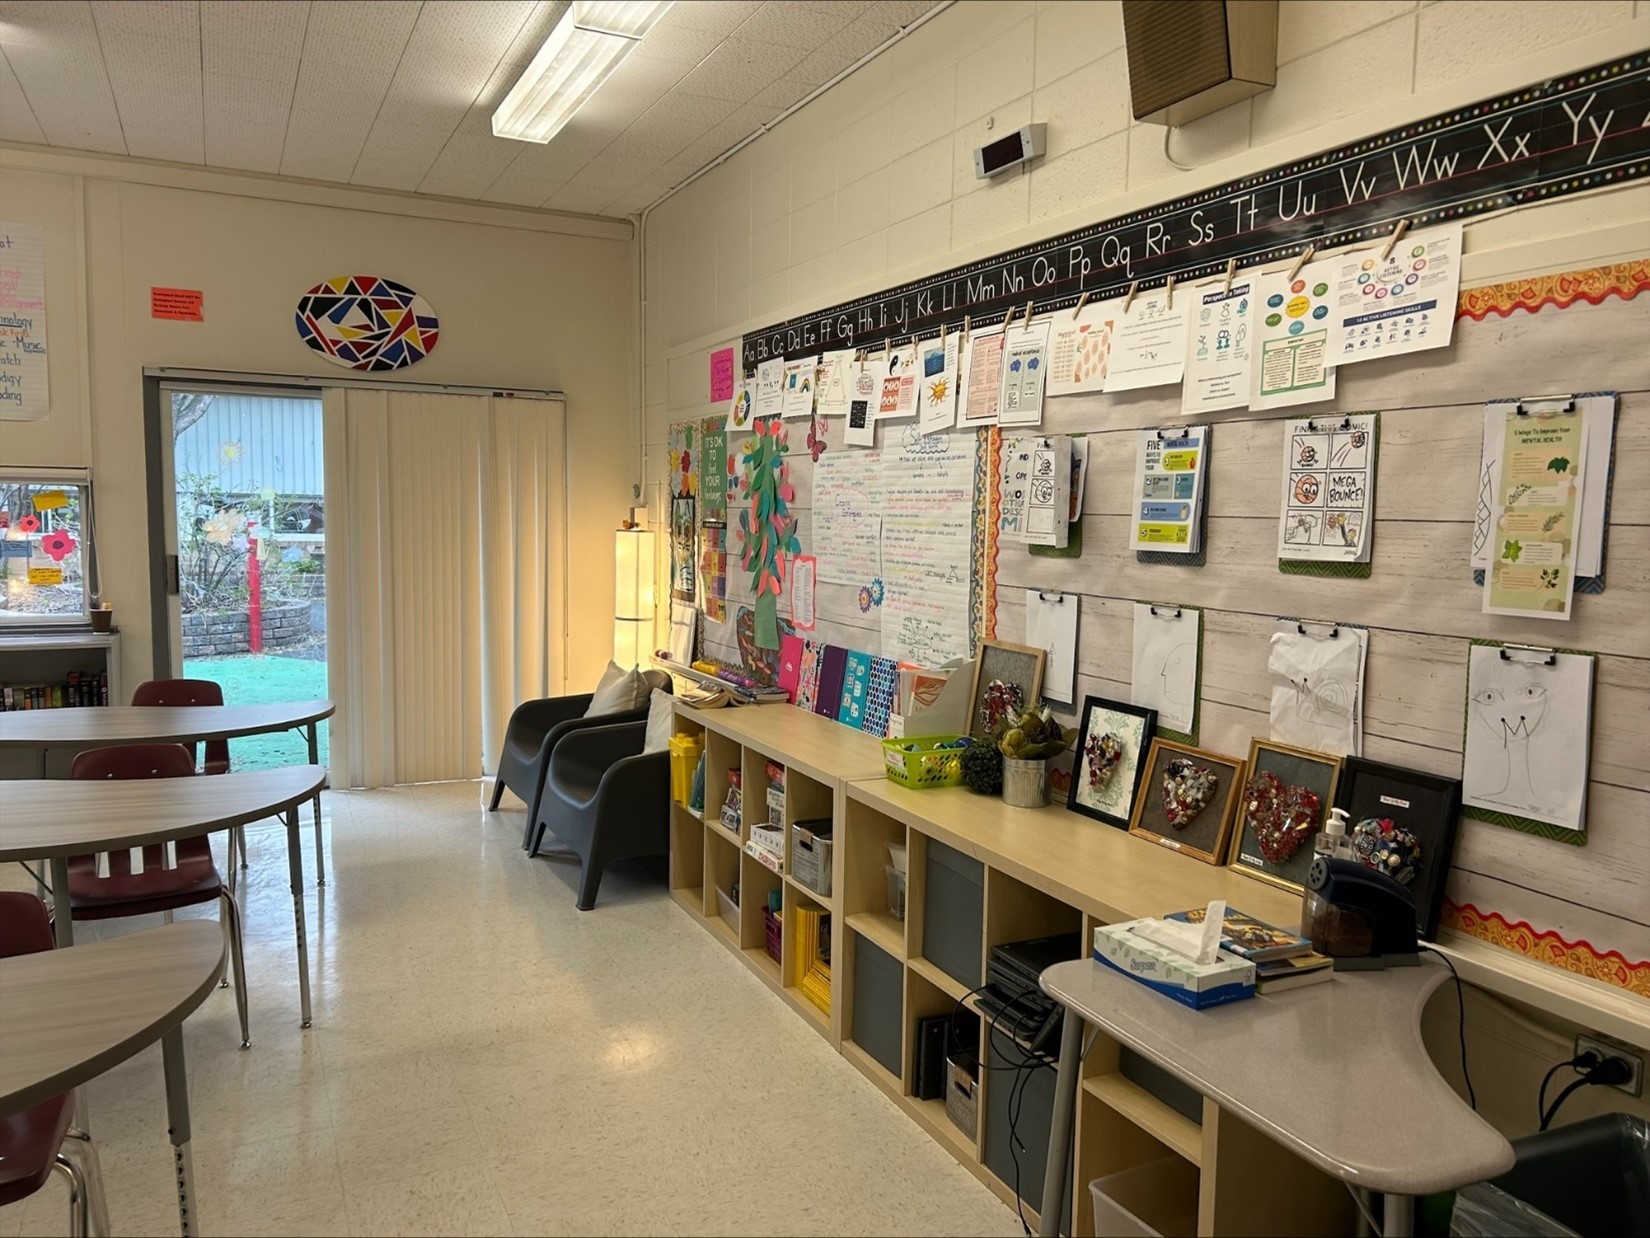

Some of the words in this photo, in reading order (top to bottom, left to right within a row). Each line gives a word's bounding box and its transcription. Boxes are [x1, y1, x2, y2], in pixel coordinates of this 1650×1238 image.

[743, 343, 754, 362] Aa
[757, 339, 768, 360] Bb
[772, 334, 784, 355] Cc
[787, 330, 800, 350] Dd
[804, 324, 815, 348] Ee
[820, 319, 832, 343] Ff
[837, 315, 853, 346] Gg
[859, 309, 873, 334] Hh
[879, 303, 887, 328] Ii
[895, 298, 908, 333] Jj
[917, 292, 933, 317] Kk
[942, 283, 956, 311] Ll
[967, 276, 995, 304] Mm
[1002, 265, 1024, 294] Nn
[1032, 256, 1056, 287] Oo
[1069, 245, 1091, 289] Pp
[1101, 236, 1134, 277] Qq
[1146, 222, 1171, 258] Rr
[1188, 211, 1214, 246] Ss
[1230, 194, 1260, 234] Tt
[1278, 180, 1317, 222] Uu
[1340, 162, 1377, 205] Vv
[1393, 139, 1459, 190] Ww
[1477, 117, 1531, 169] Xx
[1562, 92, 1615, 164] Yy
[1404, 305, 1422, 313] SKILLS
[1147, 439, 1161, 450] FIVE
[1332, 476, 1357, 488] MEGA
[1003, 489, 1025, 499] WO
[1329, 488, 1363, 503] BOUNCE!
[1142, 506, 1150, 516] 4
